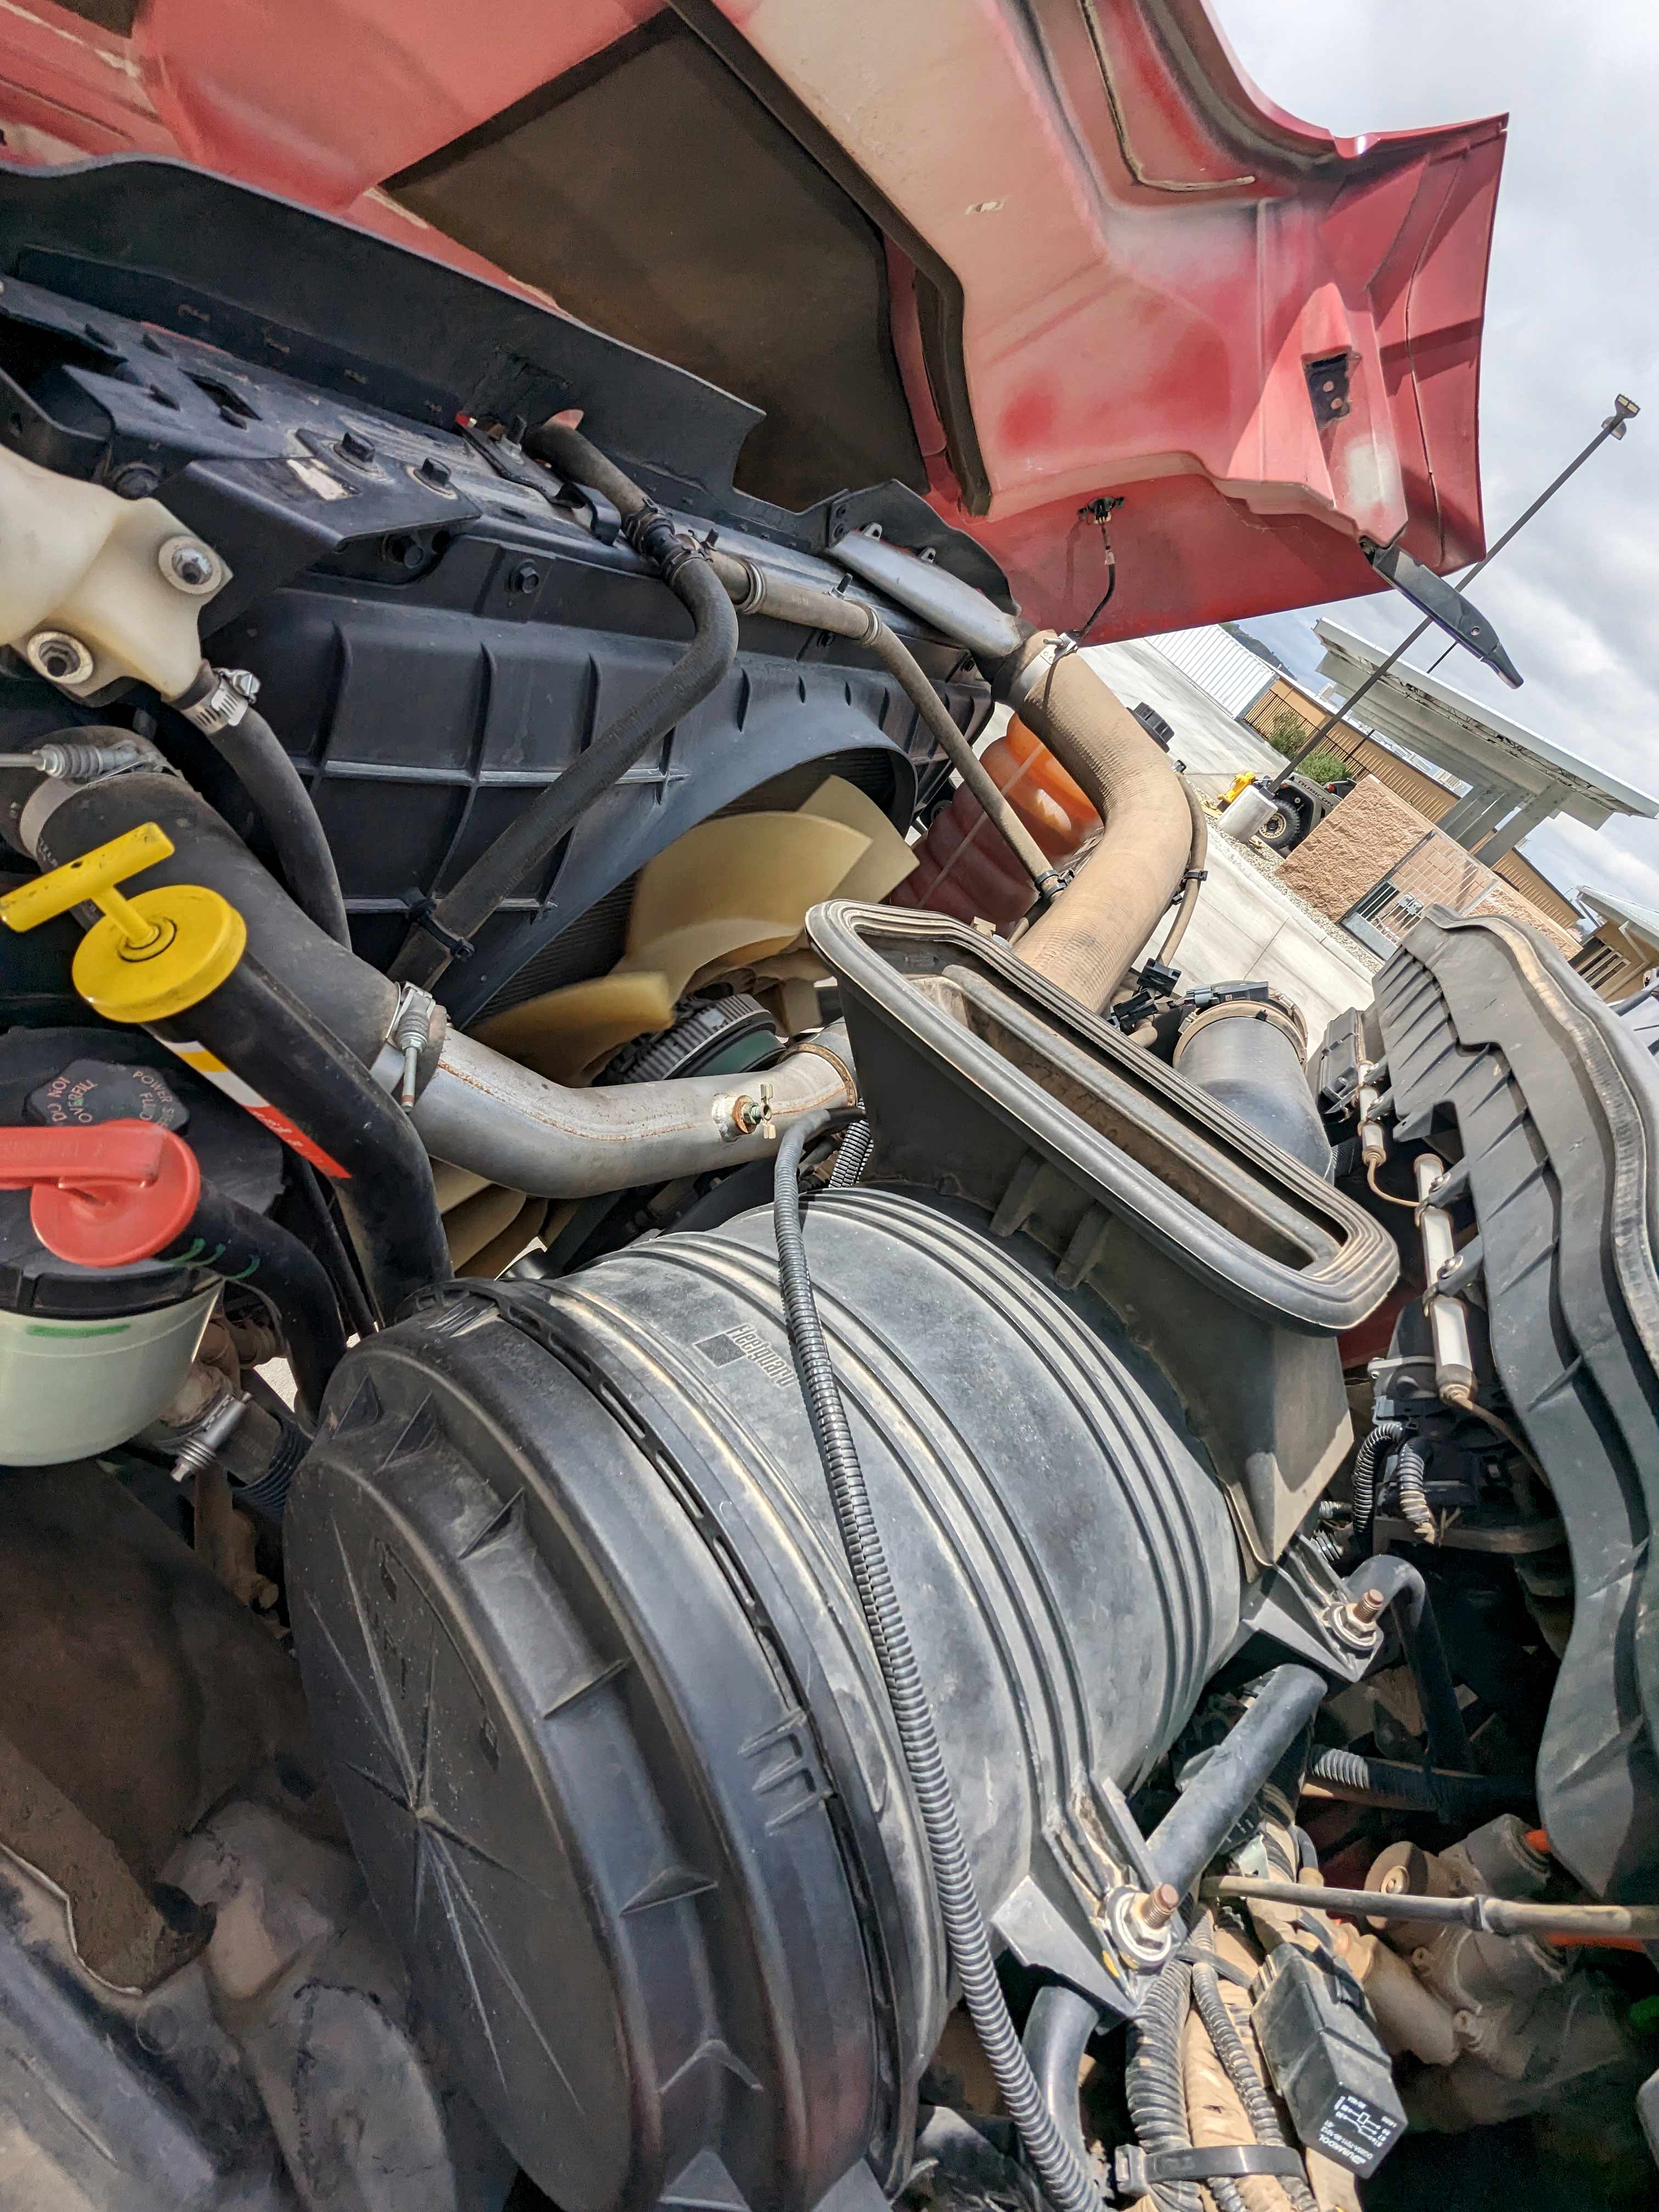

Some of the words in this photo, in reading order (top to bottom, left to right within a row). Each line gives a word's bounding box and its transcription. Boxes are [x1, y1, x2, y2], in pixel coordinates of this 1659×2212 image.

[1298, 780, 1334, 807] RUBICON
[48, 1076, 71, 1098] NOT
[133, 1071, 172, 1103] POWER
[48, 1103, 67, 1122] DO
